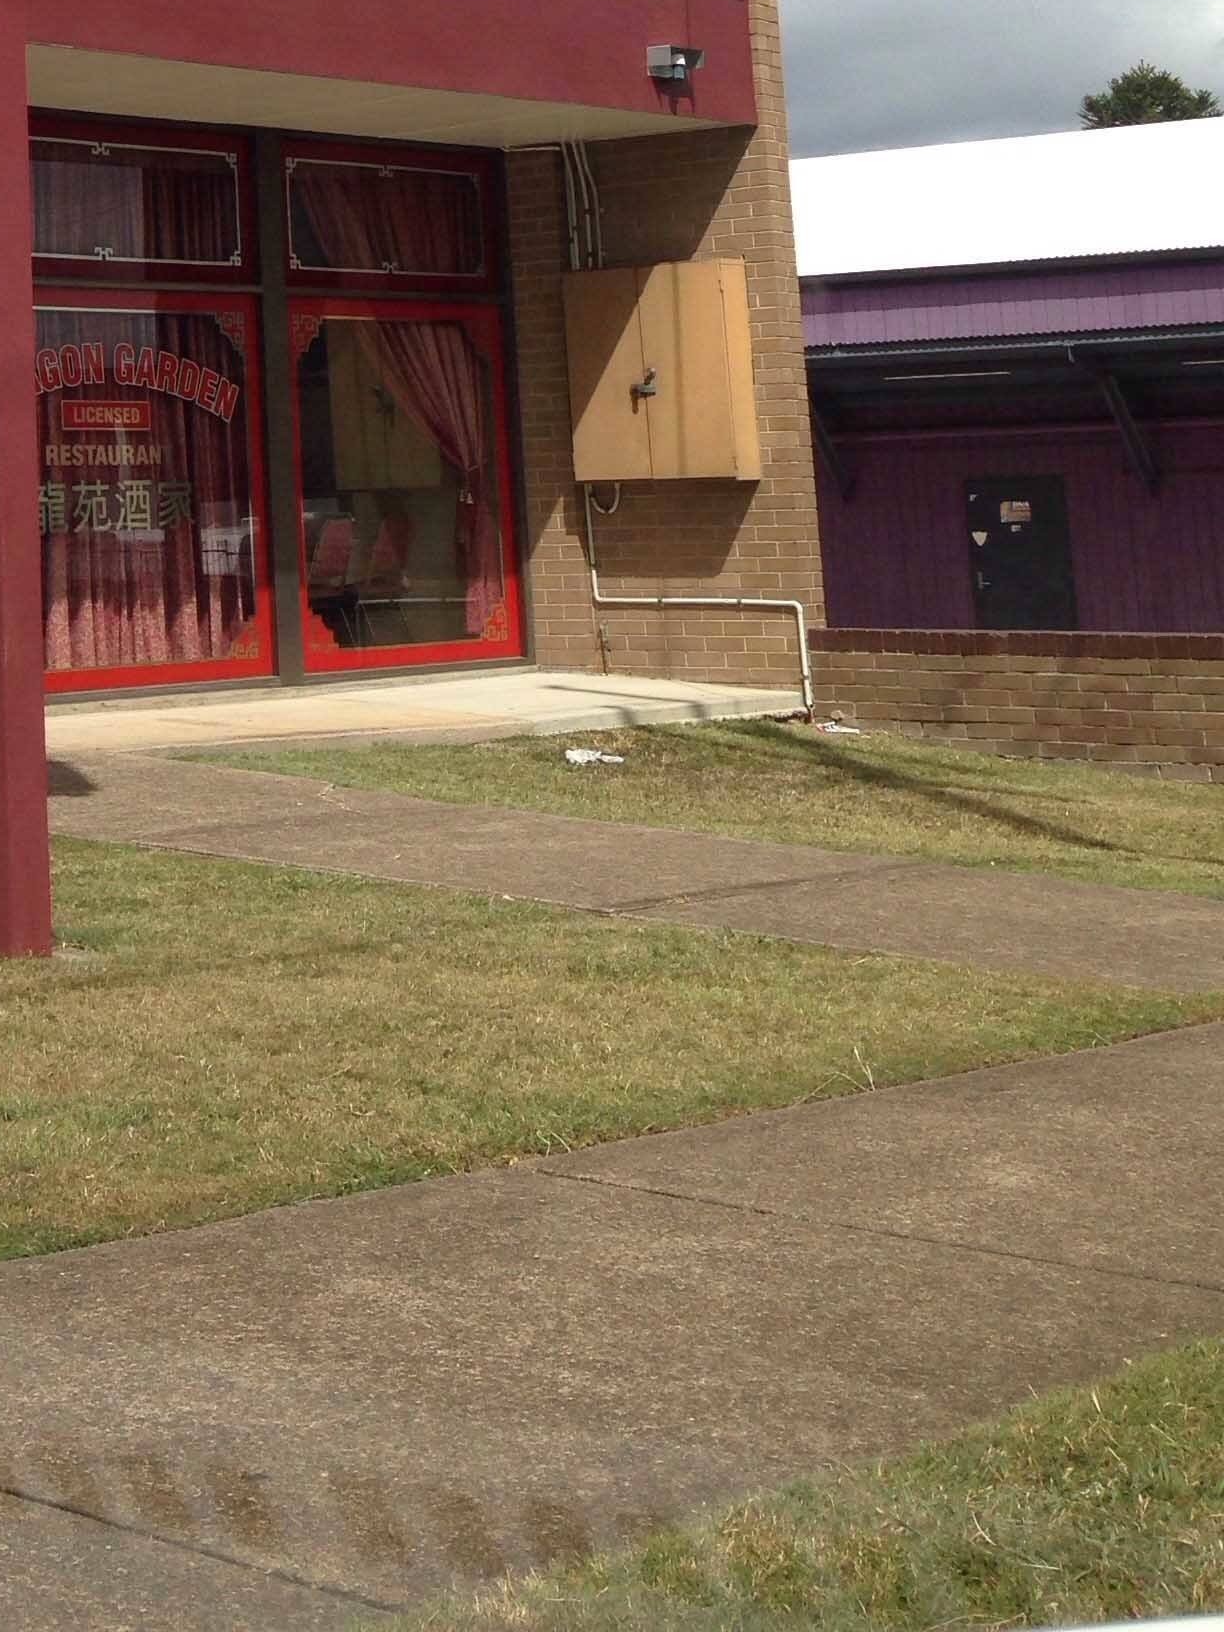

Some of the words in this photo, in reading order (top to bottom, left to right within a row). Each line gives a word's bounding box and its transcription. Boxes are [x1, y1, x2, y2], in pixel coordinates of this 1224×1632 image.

[36, 342, 105, 395] GON
[113, 342, 240, 424] GARDEN
[72, 406, 141, 425] LICENSED
[44, 444, 170, 466] RESTAURAN
